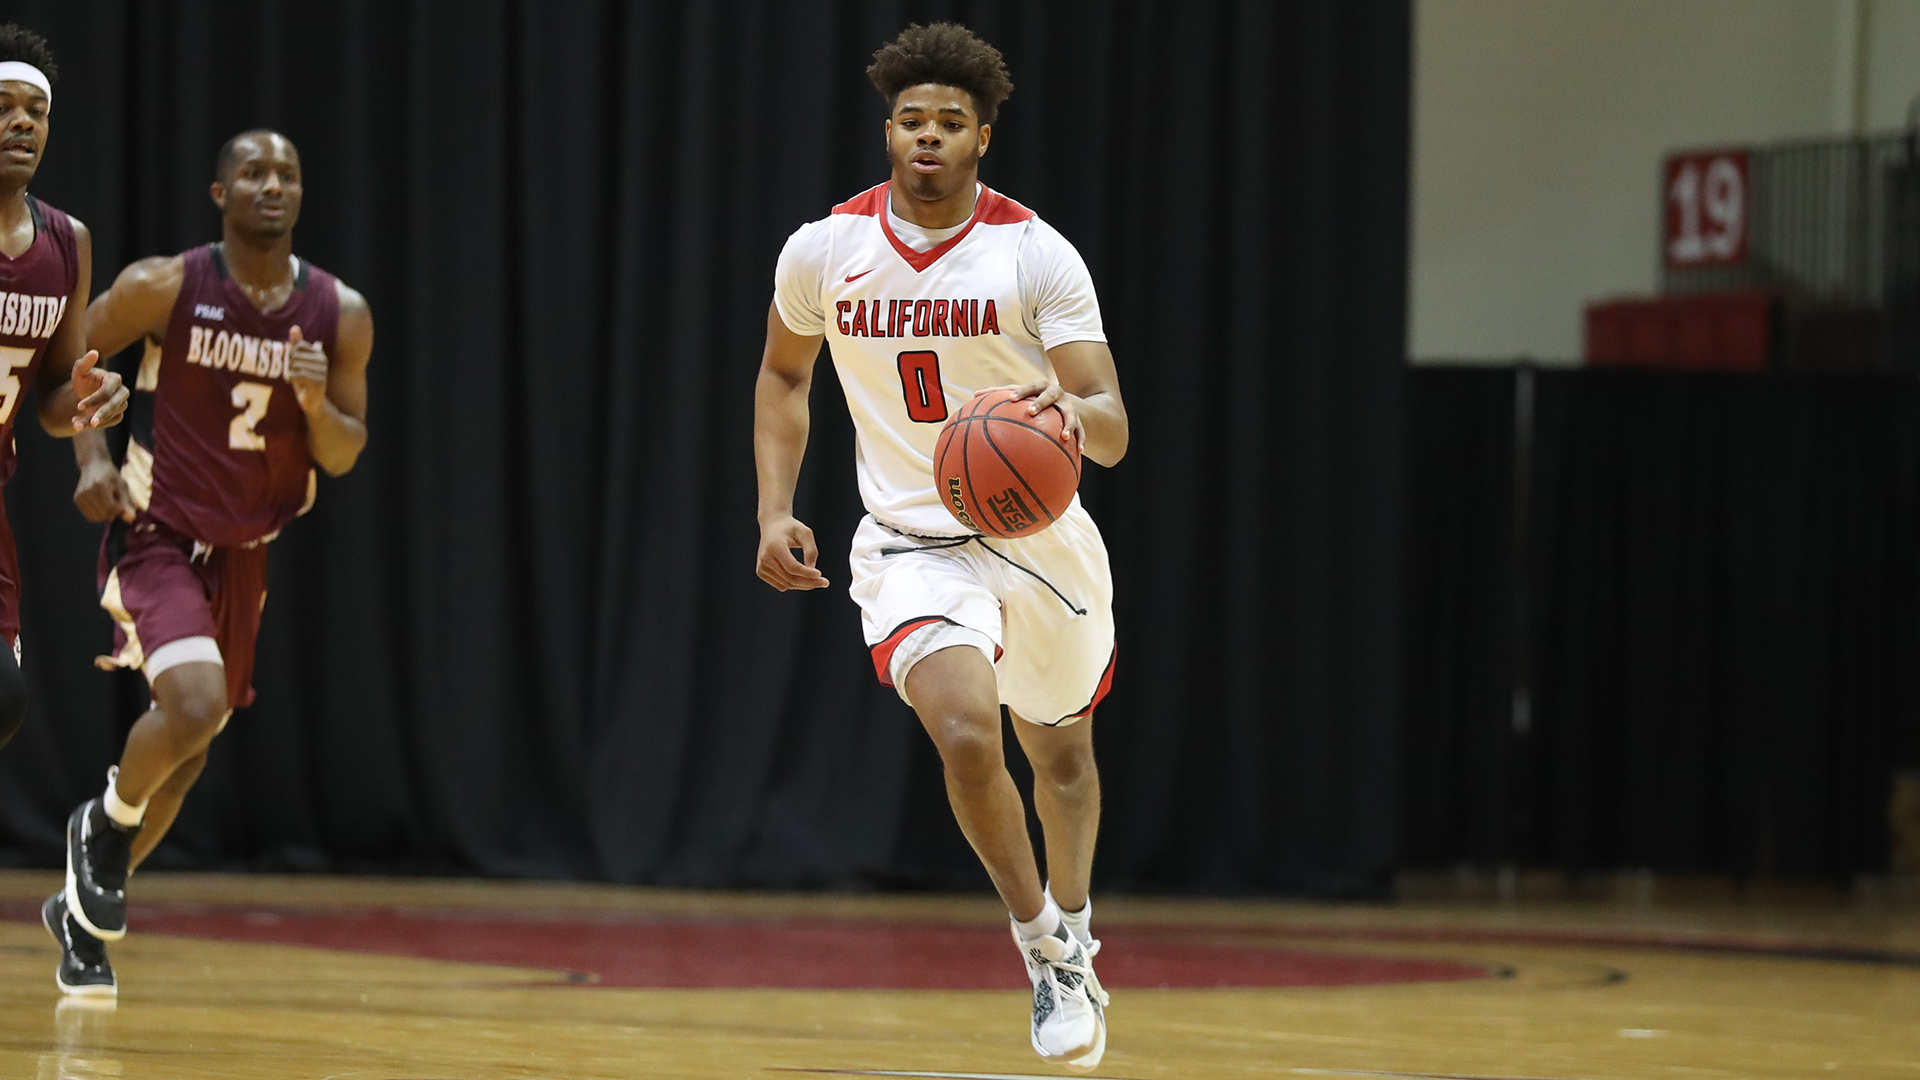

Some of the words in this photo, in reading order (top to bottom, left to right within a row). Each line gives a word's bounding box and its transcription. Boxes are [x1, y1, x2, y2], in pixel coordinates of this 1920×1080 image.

[1669, 157, 1744, 263] 19
[835, 298, 1000, 338] CALIFORNIA
[0, 346, 37, 425] 5
[228, 380, 273, 451] 2
[896, 350, 949, 423] 0
[993, 489, 1031, 531] PSAC
